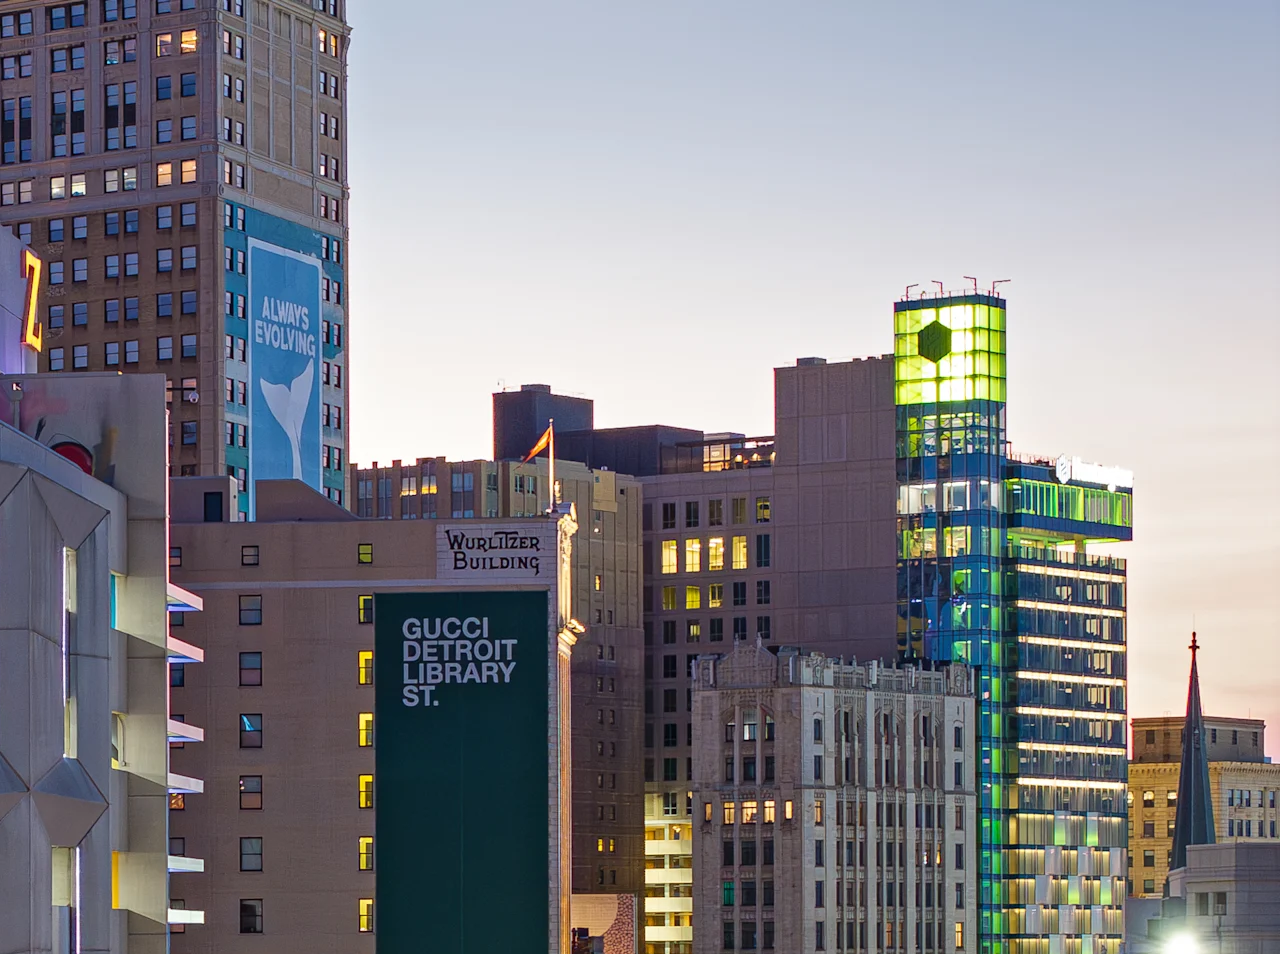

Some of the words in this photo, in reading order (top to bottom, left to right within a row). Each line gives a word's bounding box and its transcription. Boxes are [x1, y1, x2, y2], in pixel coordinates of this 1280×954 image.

[262, 296, 310, 330] ALWAYS
[255, 319, 316, 358] EVOLVING
[445, 529, 540, 552] WURLITZER
[453, 551, 540, 576] BUILDING
[402, 617, 489, 639] GUCCI
[403, 639, 518, 661] DETROIT
[403, 662, 517, 684] LIBRARY
[402, 685, 439, 706] ST.
